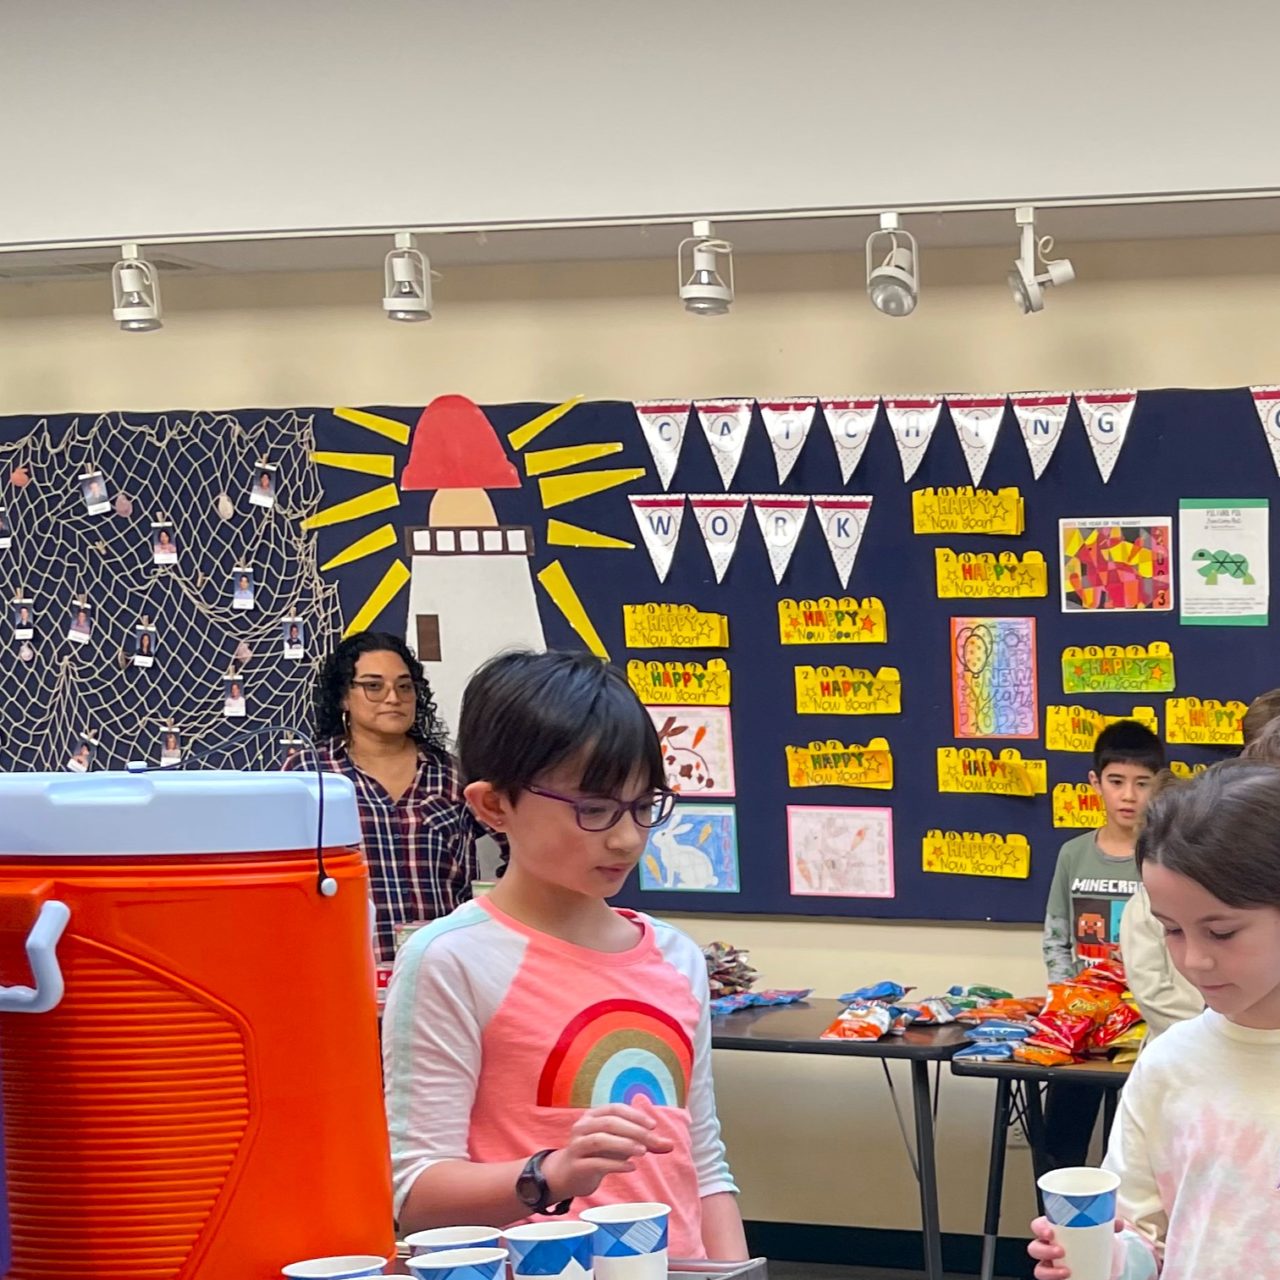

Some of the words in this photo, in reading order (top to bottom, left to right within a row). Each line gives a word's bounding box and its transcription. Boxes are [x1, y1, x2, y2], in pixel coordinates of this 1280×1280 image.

[657, 411, 1115, 442] CATCHING
[647, 513, 850, 539] WORK
[1071, 878, 1141, 894] MINECRA
